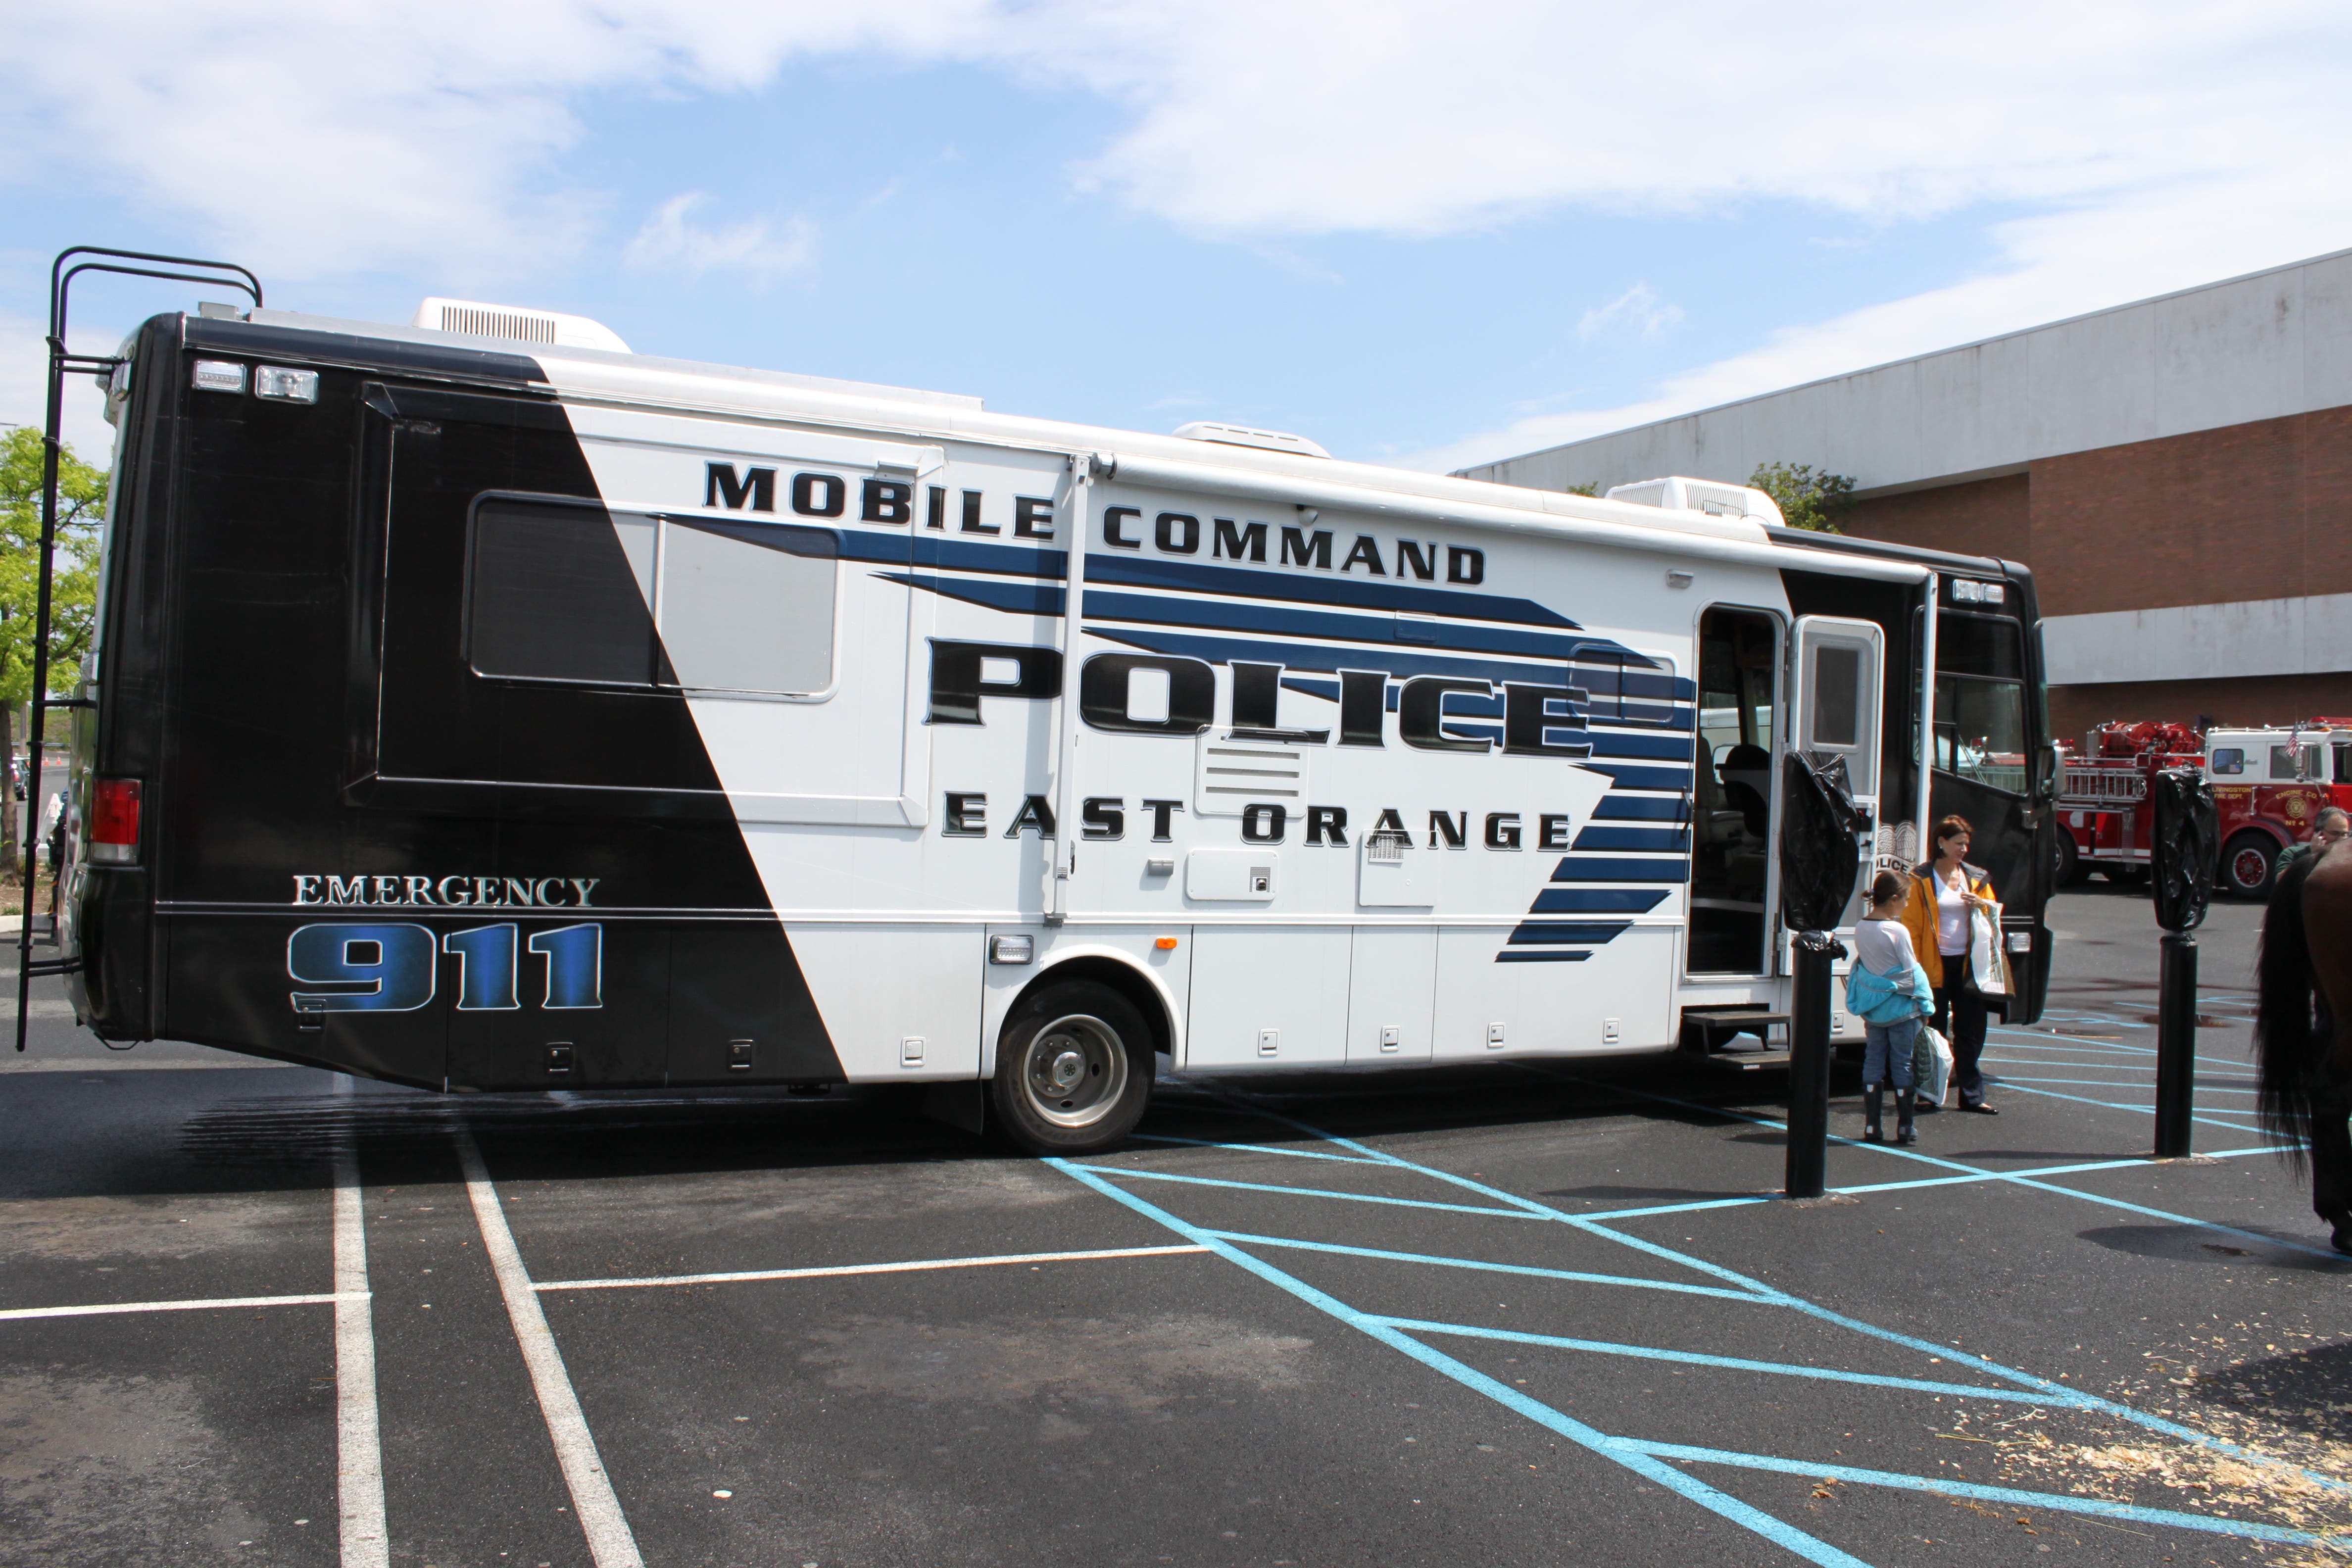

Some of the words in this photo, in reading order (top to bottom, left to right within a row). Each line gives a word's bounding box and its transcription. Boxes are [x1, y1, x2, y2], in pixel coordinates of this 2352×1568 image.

[702, 460, 1056, 543] MOBILE
[1102, 504, 1486, 586] COMMAND
[921, 637, 1593, 760] POLICE
[941, 791, 1185, 842] EAST
[1240, 802, 1570, 853] ORANGE
[2276, 789, 2303, 800] ENGINE
[292, 875, 600, 907] EMERGENCY
[1876, 858, 1909, 874] LICE
[287, 922, 603, 1013] 911
